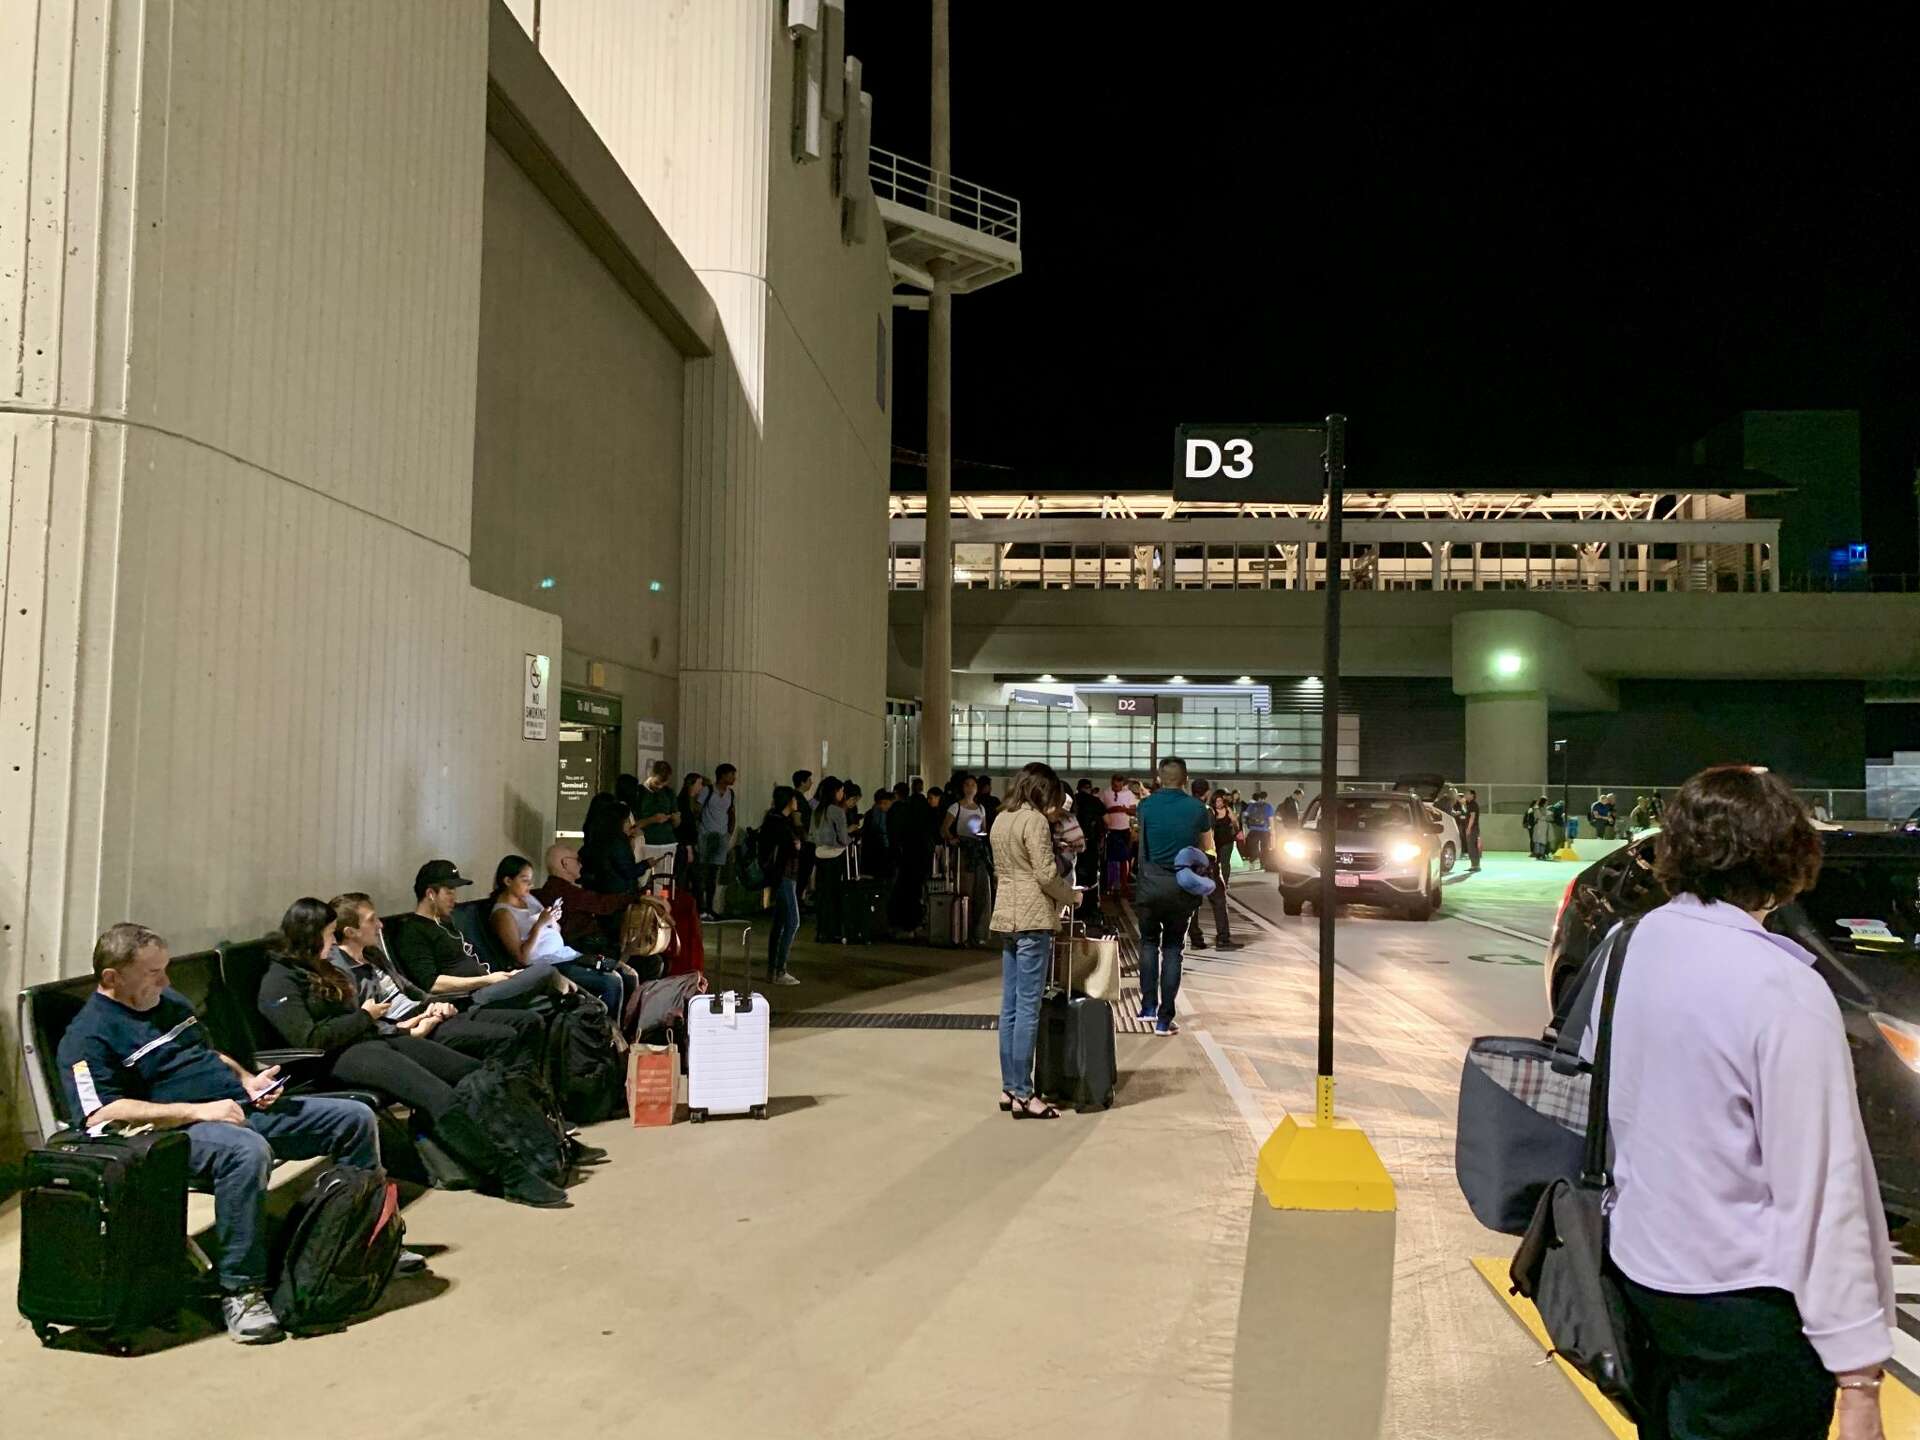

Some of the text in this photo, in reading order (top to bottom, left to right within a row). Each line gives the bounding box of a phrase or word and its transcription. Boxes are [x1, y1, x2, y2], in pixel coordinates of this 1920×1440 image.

[1185, 438, 1254, 479] D3
[532, 692, 540, 704] NO
[1118, 699, 1136, 711] D2
[526, 706, 546, 720] SMOKING
